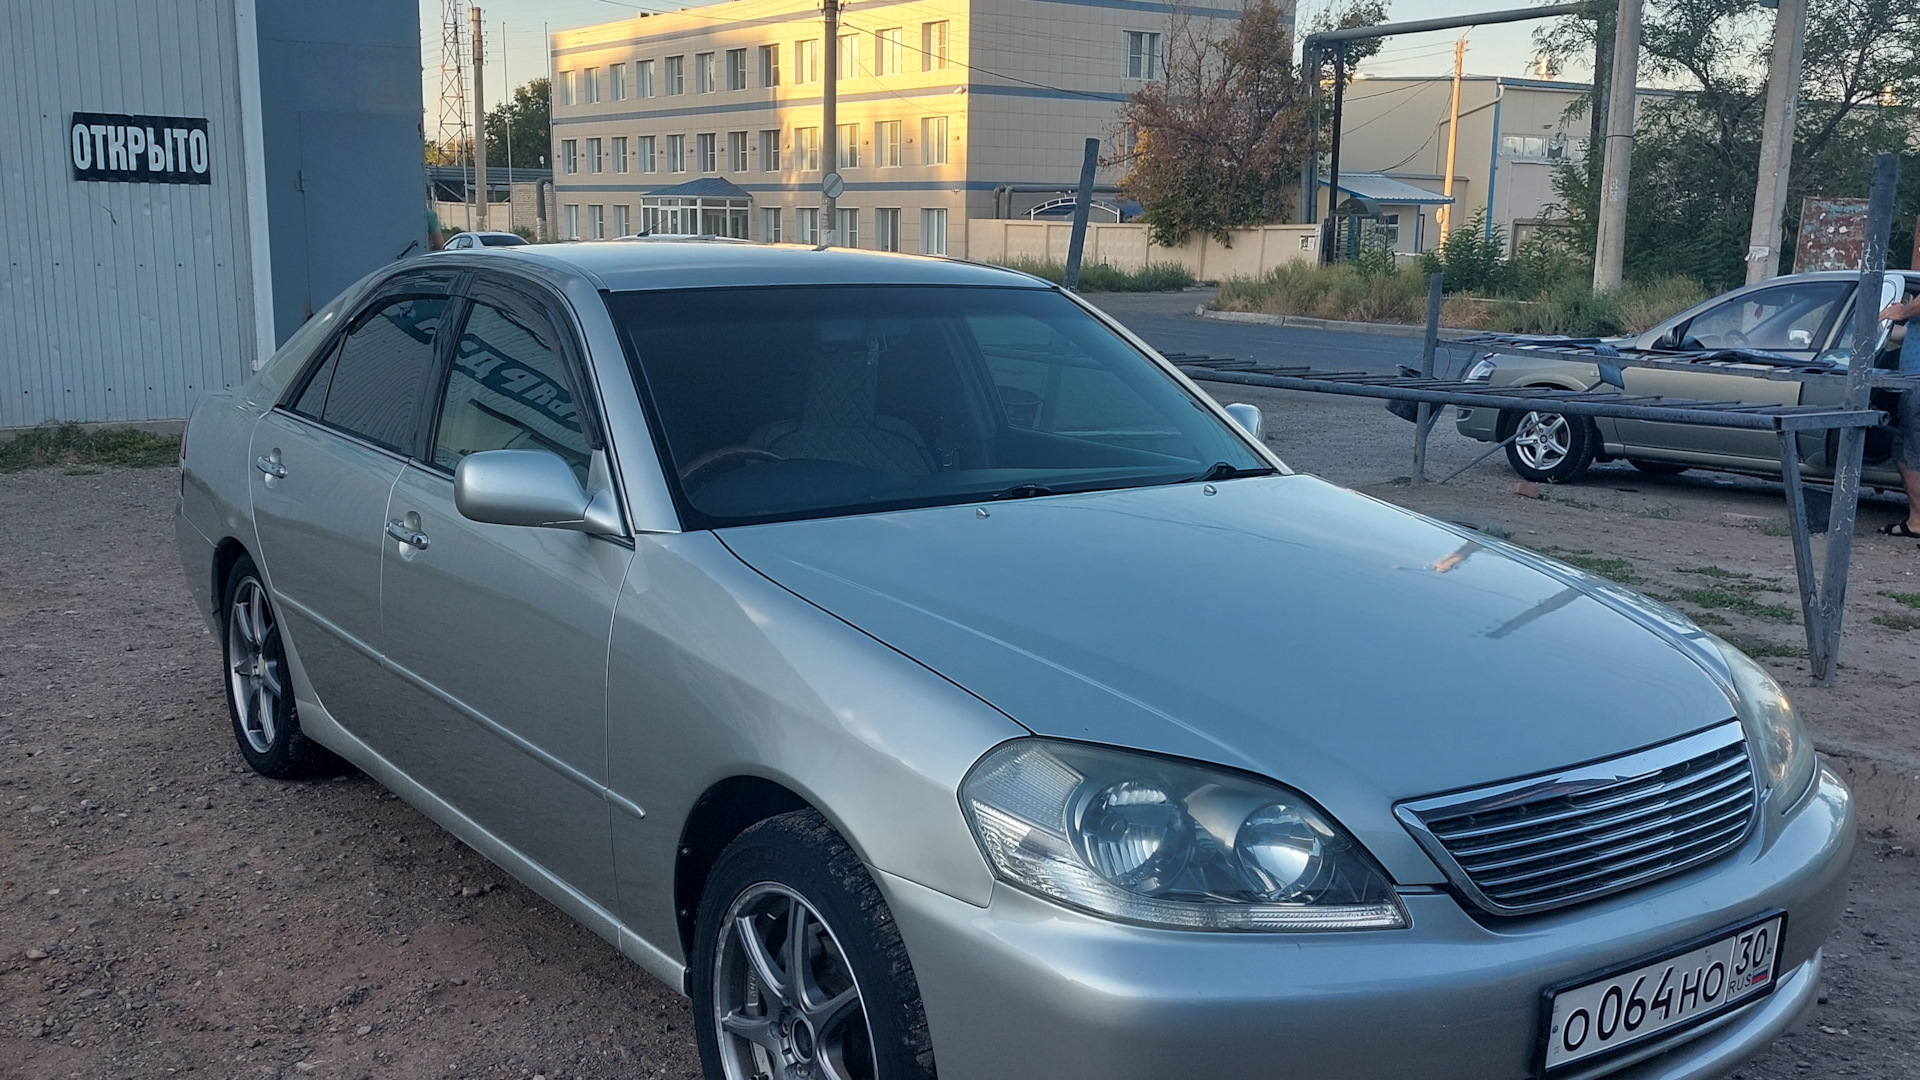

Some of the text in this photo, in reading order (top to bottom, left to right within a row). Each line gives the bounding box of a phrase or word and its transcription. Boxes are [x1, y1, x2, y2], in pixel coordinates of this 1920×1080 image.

[72, 123, 208, 174] ОТКРЫТО
[1735, 928, 1767, 975] 30
[1728, 973, 1752, 994] RUS
